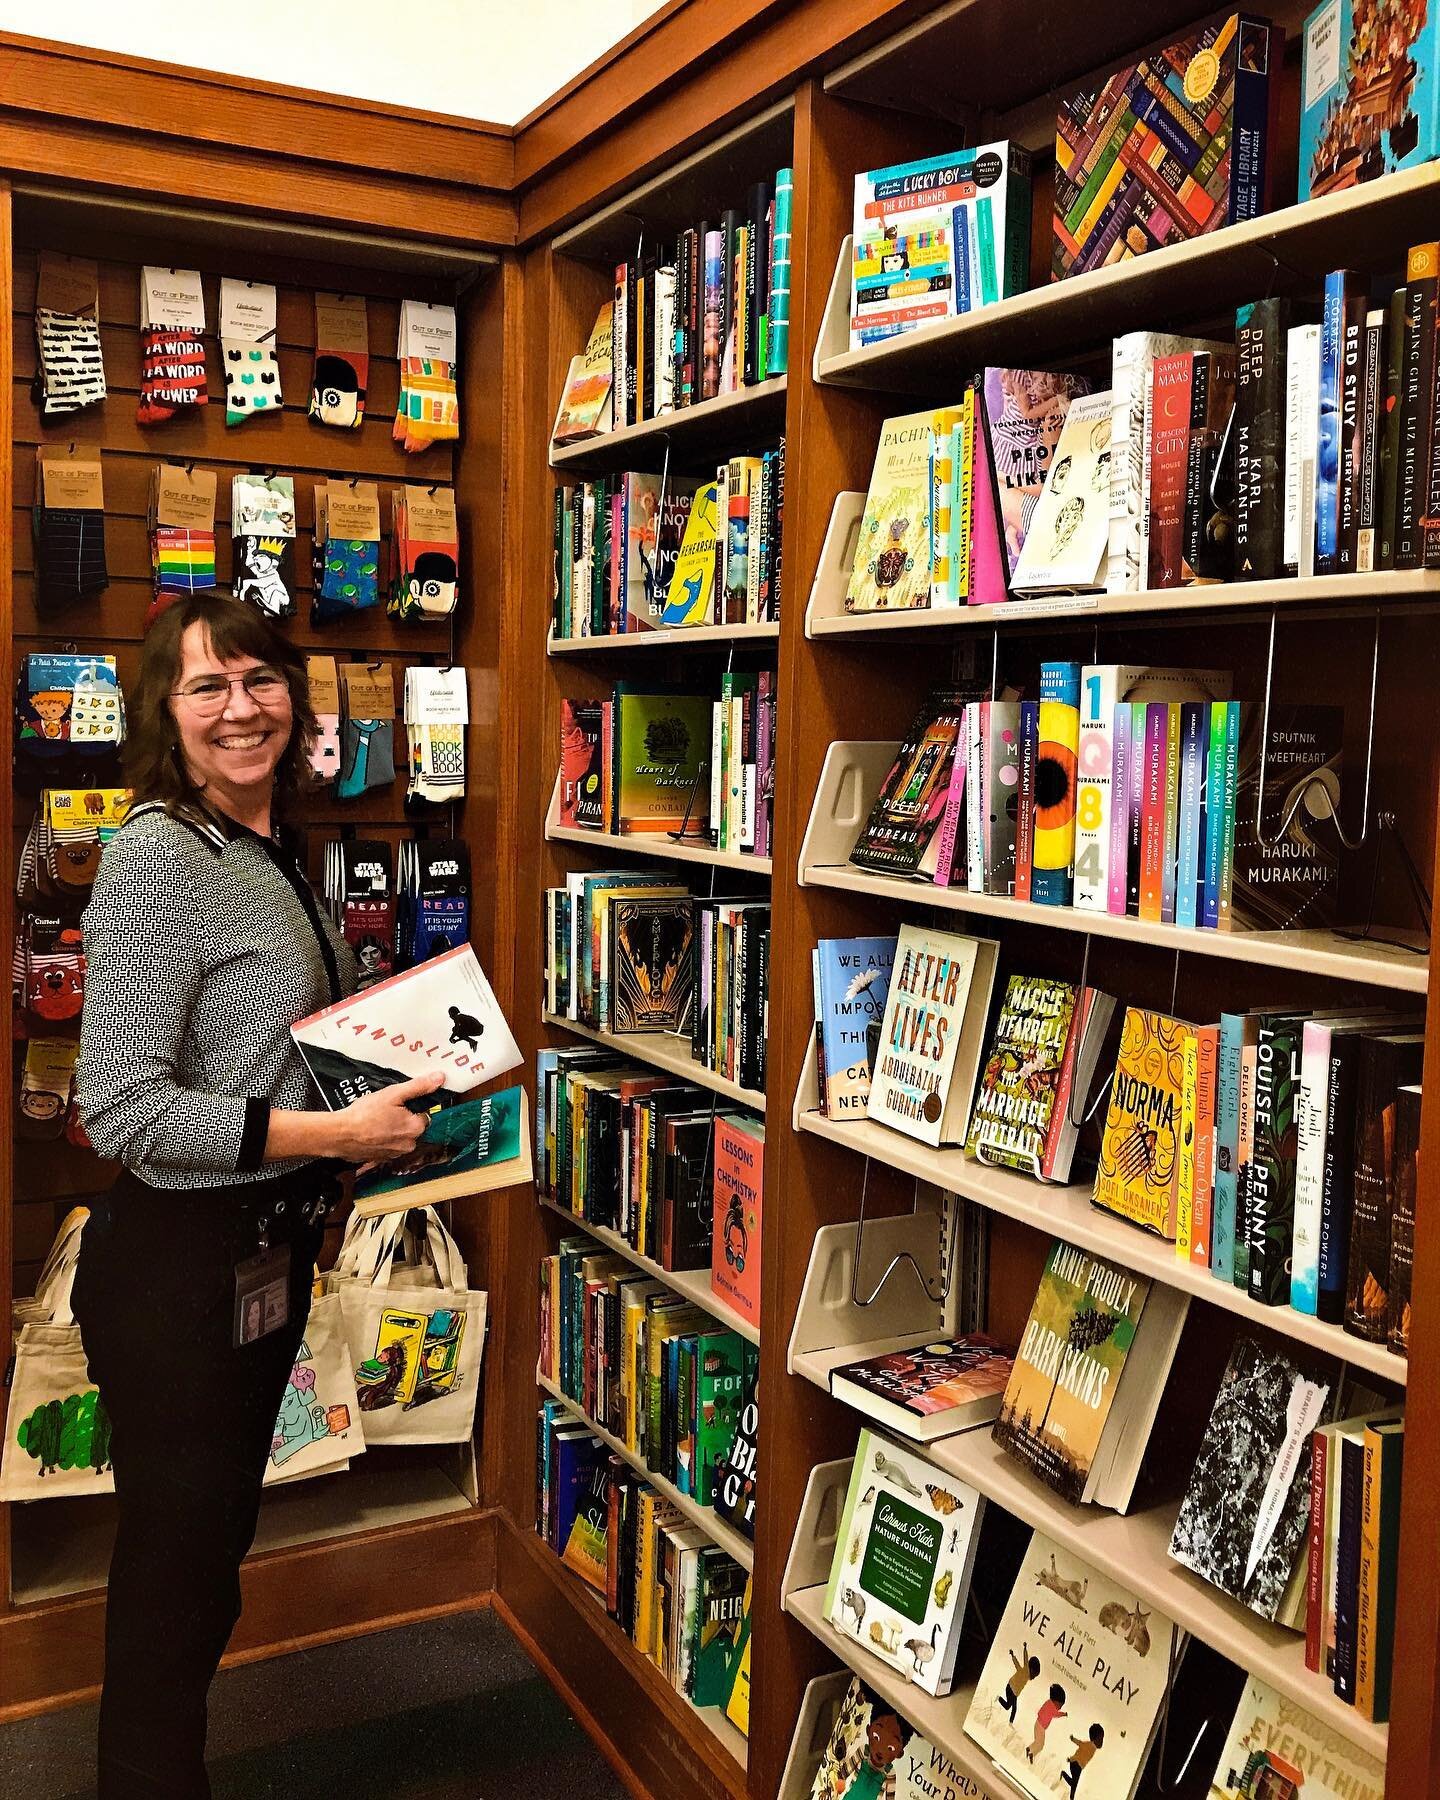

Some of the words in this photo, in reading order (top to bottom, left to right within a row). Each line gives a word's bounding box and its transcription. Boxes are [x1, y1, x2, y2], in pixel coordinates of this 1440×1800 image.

[1240, 128, 1251, 183] LIBRARY
[903, 172, 936, 193] LUCKY
[917, 190, 947, 206] RUNNER
[158, 333, 180, 341] AFTER
[1345, 325, 1359, 366] BED
[1410, 292, 1423, 360] DARLING
[152, 344, 163, 353] A
[166, 341, 204, 356] WORD
[158, 356, 181, 364] AFTER
[1239, 328, 1250, 387] RIVER
[1251, 328, 1264, 379] DEEP
[154, 366, 164, 376] A
[167, 365, 205, 379] WORD
[1158, 372, 1189, 388] MAAS
[1408, 366, 1419, 403] GIRL
[154, 388, 198, 404] POWER
[1344, 375, 1357, 427] STUY
[1156, 438, 1187, 455] CITY
[1407, 416, 1417, 442] LIZ
[1249, 457, 1262, 509] KARL
[1344, 448, 1353, 483] JERRY
[761, 462, 770, 544] COUNTERFEIT
[1237, 427, 1249, 545] MARLANTES
[1403, 446, 1415, 530] MICHALSKI
[1343, 487, 1352, 530] McGILL
[681, 539, 716, 557] REHEARSAL
[959, 519, 968, 583] LIPPMAN
[774, 556, 783, 620] CHRISTIE
[1086, 675, 1101, 720] 1
[936, 717, 960, 728] THE
[1082, 722, 1106, 730] HARUKI
[1272, 732, 1316, 744] SPUTNIK
[431, 741, 462, 753] BOOK
[432, 752, 462, 763] BOOK
[1079, 732, 1112, 777] Q
[433, 763, 463, 774] BOOK
[635, 765, 664, 776] Heart
[668, 763, 680, 776] of
[655, 775, 696, 788] Darknes
[1022, 739, 1031, 795] MURAKAMI
[1115, 742, 1125, 802] MURAKAMI
[1133, 741, 1143, 802] MURAKAMI
[1150, 743, 1159, 806] MURAKAMI
[1167, 741, 1176, 805] MURAKAMI
[1186, 742, 1196, 806] MURAKAMI
[1212, 743, 1222, 808] MURAKAMI
[1224, 743, 1235, 809] MURAKAMI
[648, 803, 687, 812] CONRAD
[882, 799, 930, 814] DOCTOR
[1078, 786, 1103, 831] 8
[868, 826, 918, 843] MOREAU
[936, 820, 952, 874] RELAXATION
[948, 816, 958, 840] YEAR
[357, 862, 382, 870] STAR
[432, 860, 456, 869] STAR
[1075, 842, 1104, 887] 4
[1222, 846, 1230, 892] SWEETHEART
[1261, 843, 1317, 858] HARUKI
[354, 867, 384, 878] WARS
[428, 865, 459, 877] WARS
[1248, 868, 1328, 883] MURAKAMI
[347, 901, 388, 911] READ
[423, 900, 465, 910] READ
[838, 956, 861, 968] WE
[897, 949, 961, 1007] AFTER
[1010, 985, 1065, 1017] MAGGIE
[336, 1015, 485, 1075] LANDSLIDE
[888, 1004, 948, 1062] LIVES
[996, 1013, 1064, 1048] O'FARRELL
[1200, 1038, 1213, 1062] On
[881, 1054, 943, 1096] ABDULRAZAK
[1198, 1064, 1213, 1121] Animals
[1241, 1065, 1250, 1098] DELIA
[1255, 1028, 1275, 1127] LOUISE
[886, 1088, 926, 1123] GURNAH
[976, 1088, 1047, 1128] MARRIAGE
[1115, 1071, 1175, 1132] NORMA
[1327, 1057, 1342, 1136] Bewilderment
[478, 1098, 492, 1160] HOUSEGIRL
[972, 1118, 1043, 1155] PORTRAIT
[1240, 1102, 1248, 1143] OWENS
[1297, 1085, 1312, 1151] Picoult
[1307, 1104, 1322, 1138] Jodi
[721, 1137, 754, 1168] LESSONS
[733, 1162, 740, 1175] in
[1195, 1133, 1209, 1173] Susan
[716, 1167, 757, 1205] CHEMISTRY
[1179, 1152, 1194, 1194] Tommy
[1321, 1153, 1334, 1217] RICHARD
[1354, 1171, 1384, 1186] Overstory
[1101, 1177, 1119, 1196] SOFI
[1123, 1188, 1162, 1220] OKSANEN
[1194, 1177, 1209, 1226] Orlean
[1250, 1164, 1269, 1256] PENNY
[1319, 1223, 1330, 1280] POWERS
[1050, 1243, 1089, 1289] ANNIE
[1084, 1257, 1138, 1317] PROULX
[1022, 1319, 1111, 1411] BARKSKINS
[1279, 1440, 1300, 1485] RAINBOW
[1314, 1447, 1325, 1483] ANNIE
[1365, 1447, 1374, 1472] Tom
[1266, 1487, 1281, 1517] THOMAS
[1312, 1485, 1323, 1528] PROULX
[1364, 1474, 1373, 1524] Perrotta
[874, 1523, 901, 1545] NATURE
[900, 1539, 933, 1564] JOURNAL
[878, 1504, 908, 1533] Curious
[908, 1522, 934, 1548] Kids
[1255, 1517, 1271, 1552] PYNCHON
[1361, 1557, 1371, 1591] Tracy
[709, 1596, 743, 1621] NEIG
[1360, 1592, 1370, 1621] Flick
[1023, 1600, 1051, 1638] WE
[1053, 1630, 1084, 1668] ALL
[1092, 1657, 1140, 1706] PLAY
[1360, 1623, 1369, 1657] Can't
[1359, 1659, 1368, 1684] Win
